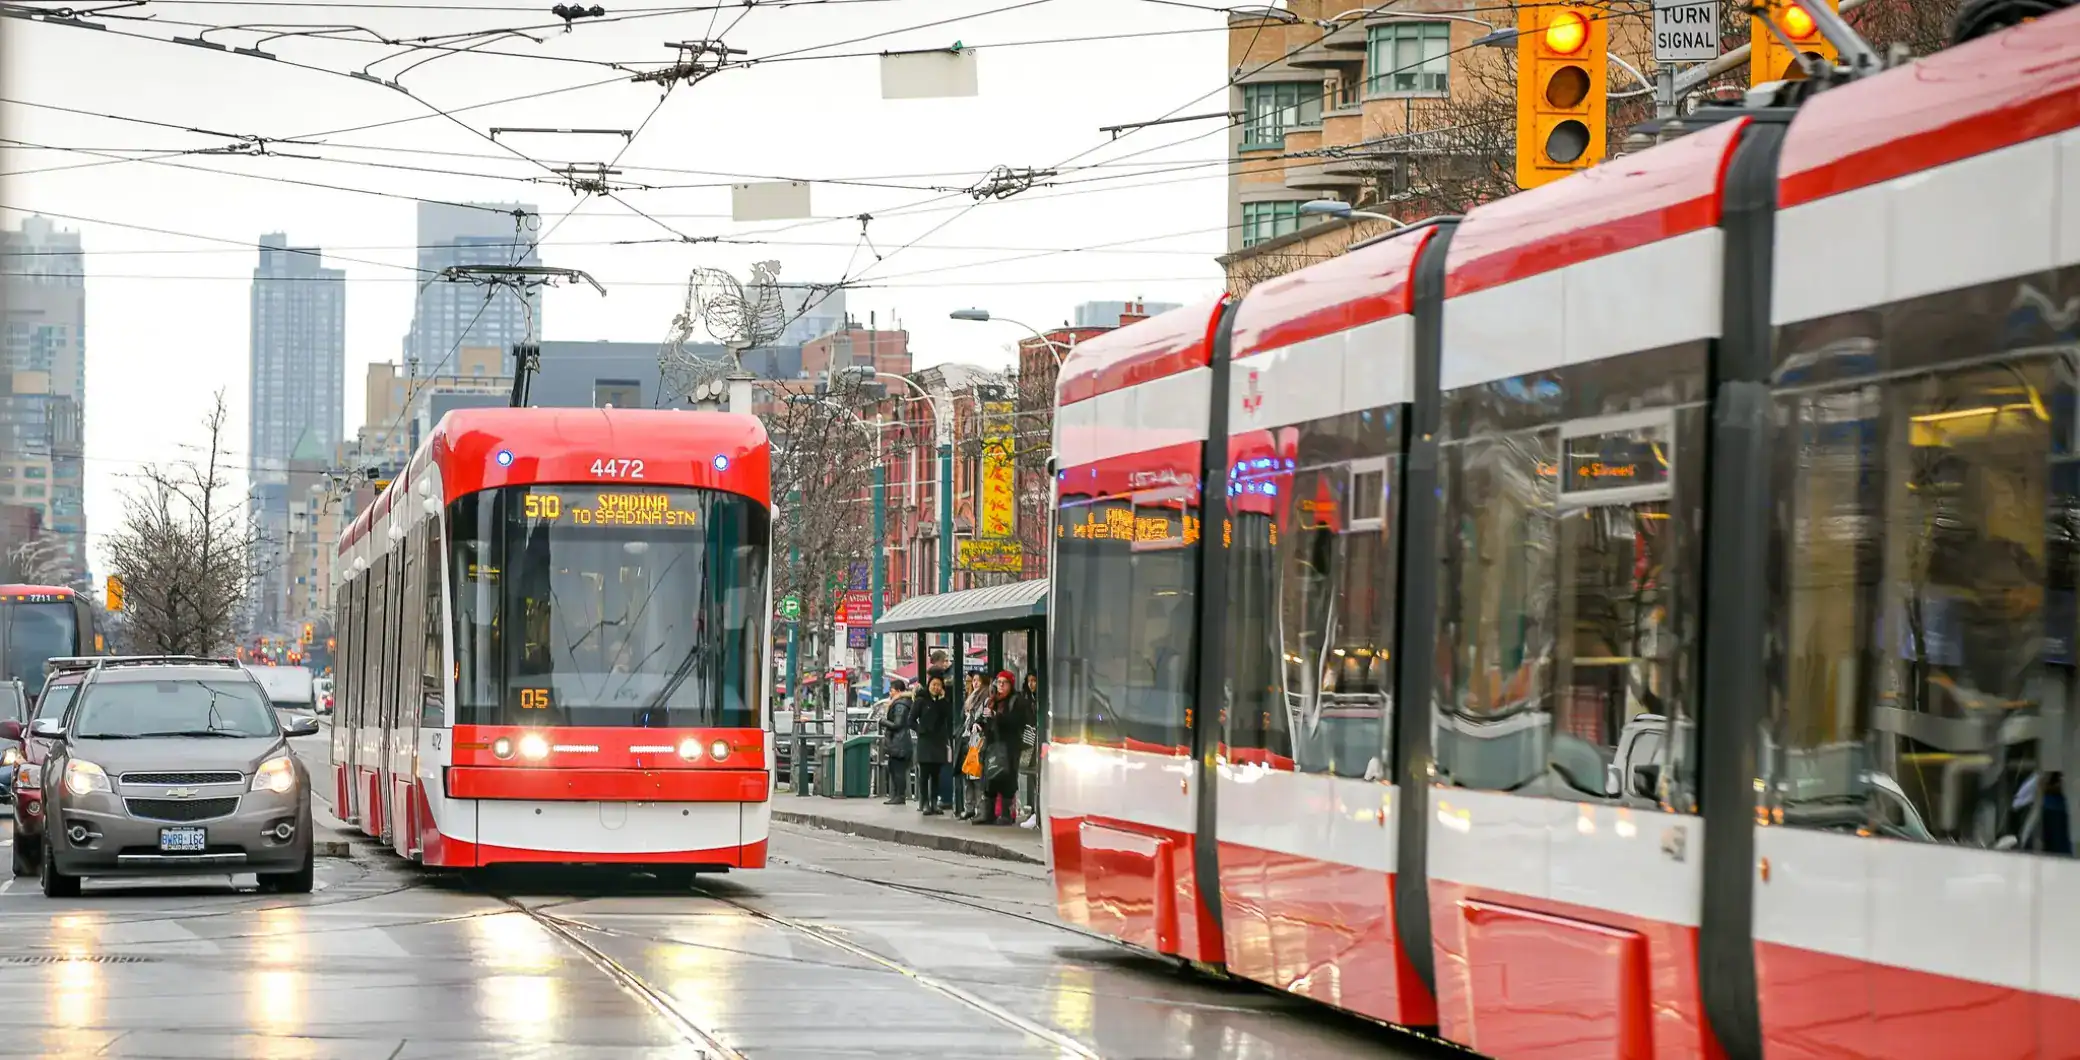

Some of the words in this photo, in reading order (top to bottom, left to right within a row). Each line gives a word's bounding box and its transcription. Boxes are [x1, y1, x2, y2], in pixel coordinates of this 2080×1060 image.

[1661, 7, 1710, 24] TURN
[1658, 32, 1714, 49] SIGNAL
[590, 459, 644, 478] 4472
[524, 494, 560, 518] 510
[597, 494, 668, 512] SPADINA
[572, 509, 591, 524] TO
[595, 509, 662, 524] SPADINA
[665, 511, 696, 526] STN
[30, 594, 51, 602] 7711
[785, 600, 798, 613] P
[521, 688, 549, 709] 05
[189, 833, 204, 845] 162
